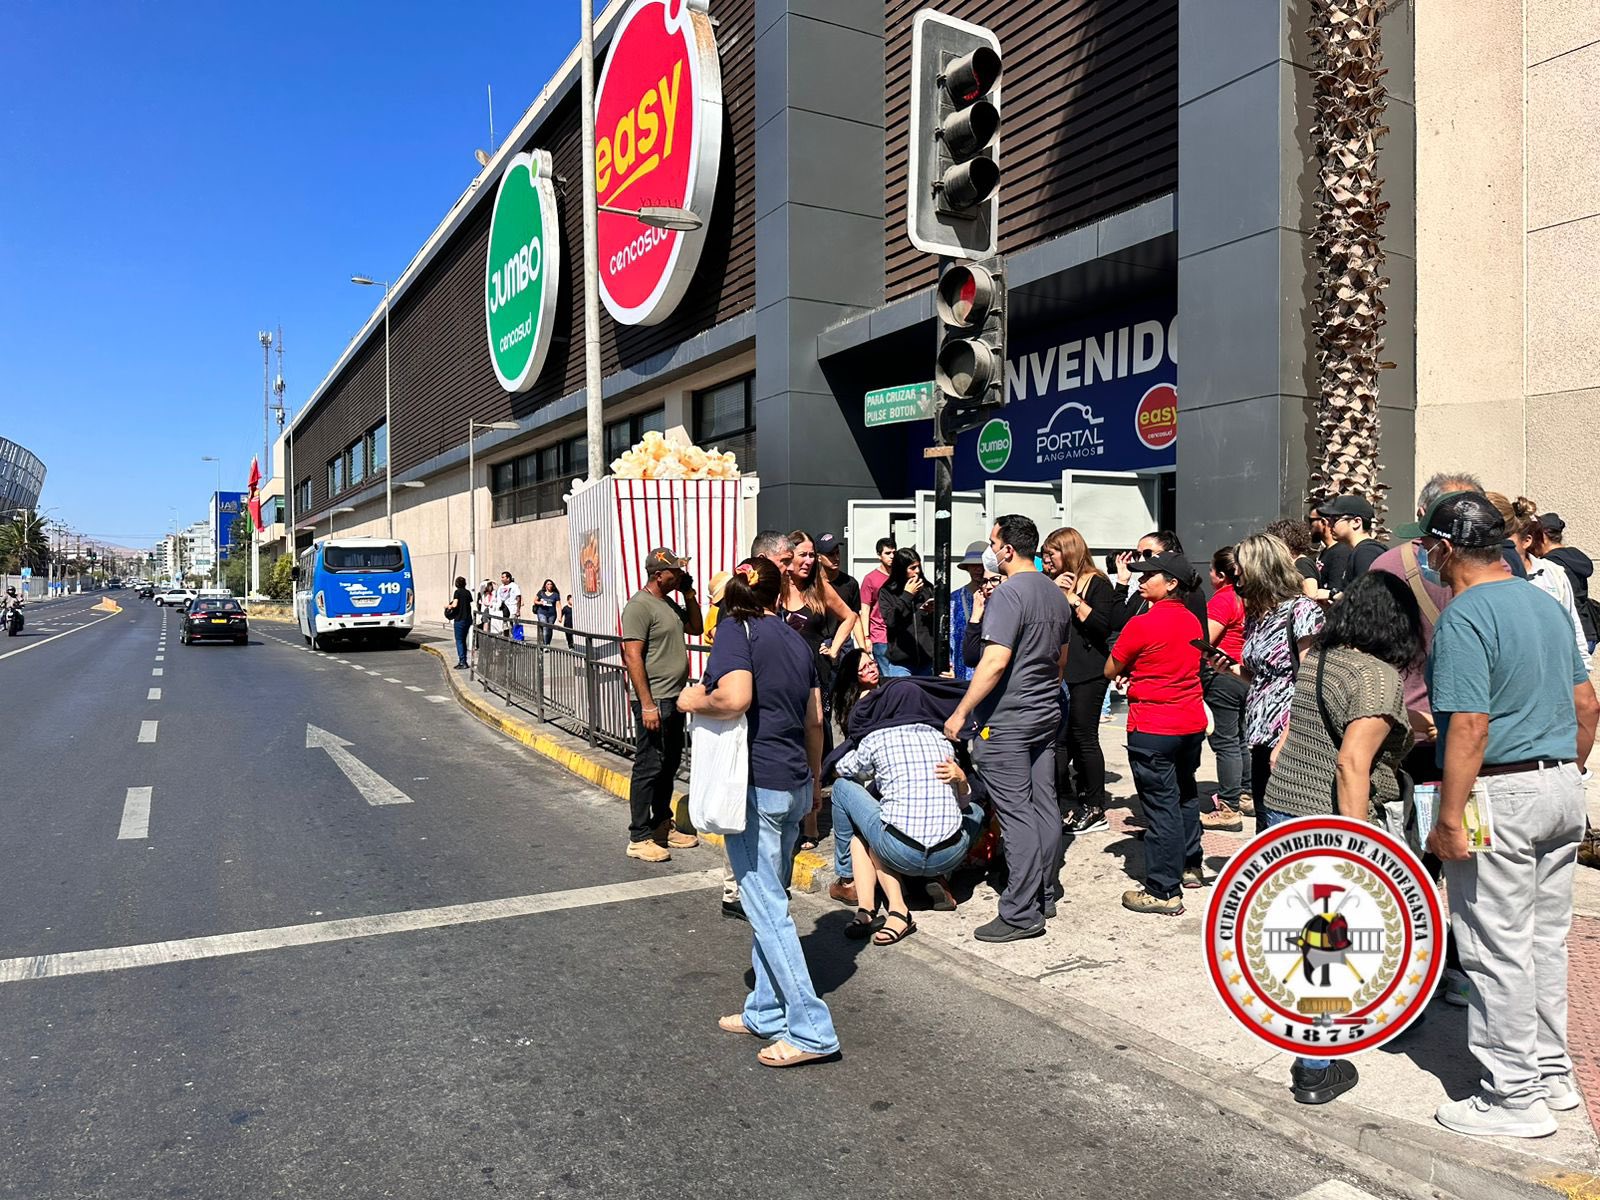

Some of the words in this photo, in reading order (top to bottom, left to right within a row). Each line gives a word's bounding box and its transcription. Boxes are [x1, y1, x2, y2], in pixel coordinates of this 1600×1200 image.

[596, 59, 682, 193] easy
[490, 236, 541, 313] JUMBO
[499, 312, 532, 353] cencosud
[867, 394, 884, 407] PARA
[885, 389, 916, 403] CRUZAR
[867, 409, 886, 422] PULSE
[889, 405, 916, 418] BOTON
[980, 438, 1009, 453] JUMBO
[1036, 432, 1104, 454] PORTAL
[1043, 447, 1096, 463] ANGAMOS
[1431, 527, 1452, 539] RAM
[378, 582, 401, 595] 119
